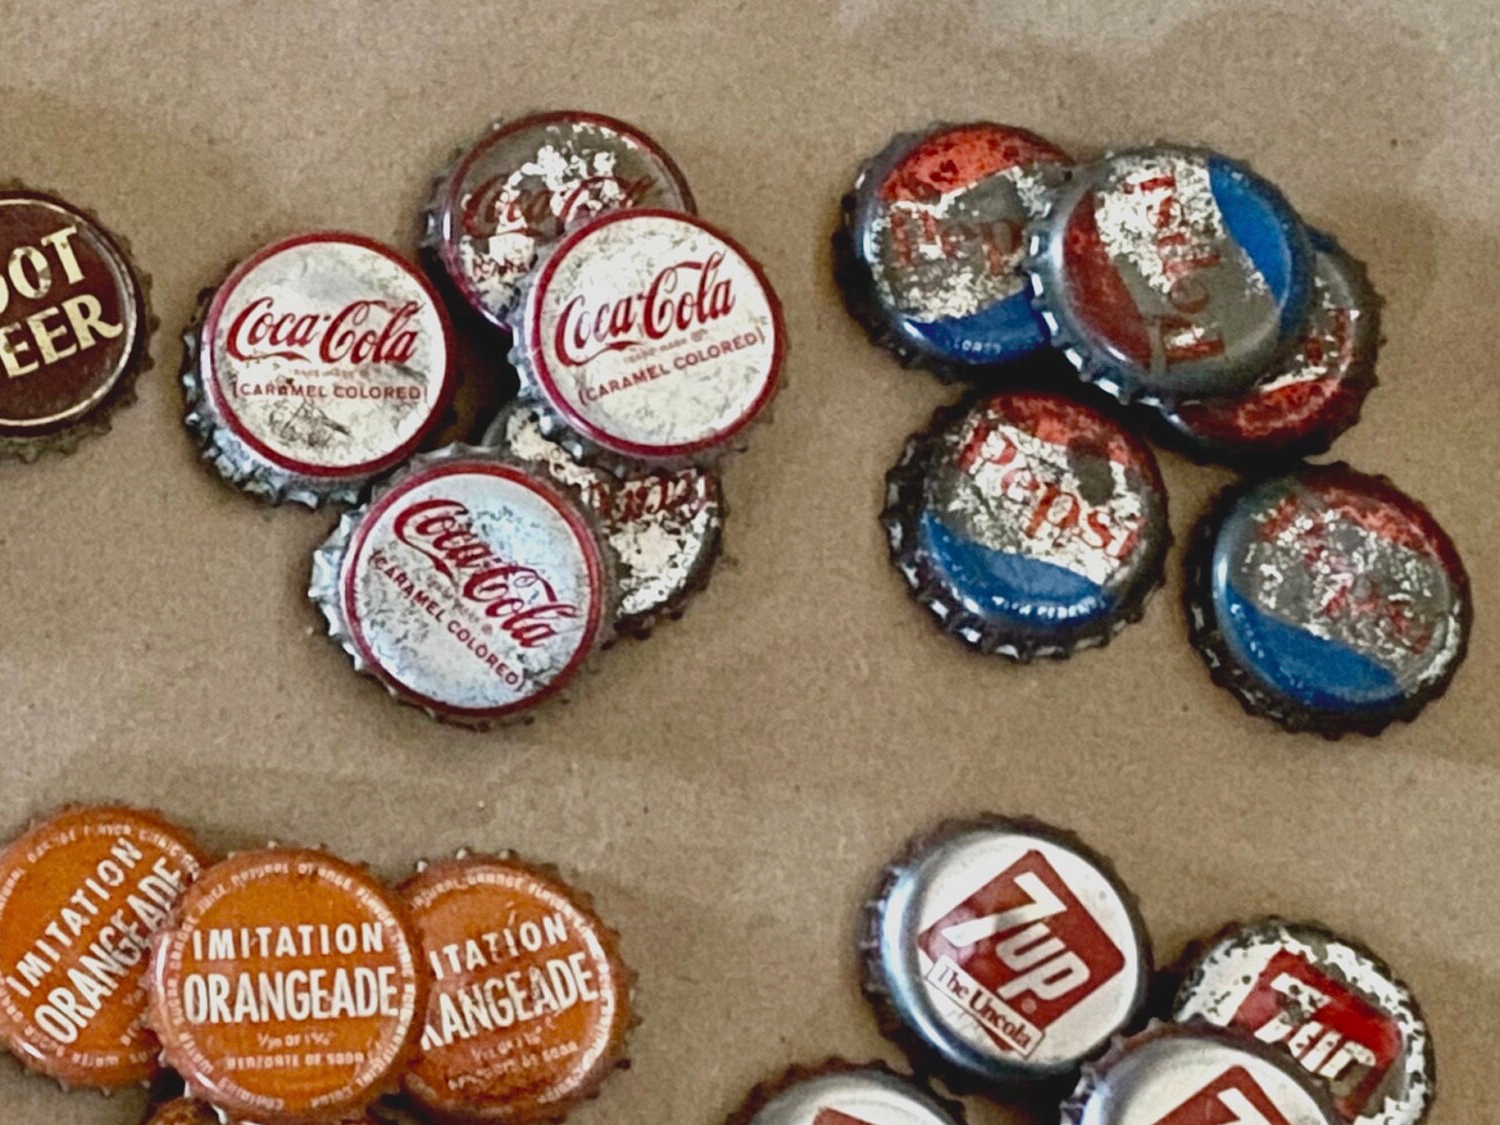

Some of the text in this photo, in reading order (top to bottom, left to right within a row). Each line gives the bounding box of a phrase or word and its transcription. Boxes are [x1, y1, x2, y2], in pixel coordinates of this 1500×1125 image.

[577, 326, 767, 407] (CARAMEL COLORED)
[447, 620, 528, 692] COLORED)
[6, 837, 143, 997] IMITATION
[35, 857, 183, 1044] ORANGEADE
[193, 922, 383, 961] IMITATION
[429, 912, 569, 980] ITATION
[184, 966, 399, 1024] ORANGEADE
[420, 952, 599, 1051] ANGEADE
[936, 963, 1034, 1051] The Uncola
[305, 1054, 321, 1067] OF
